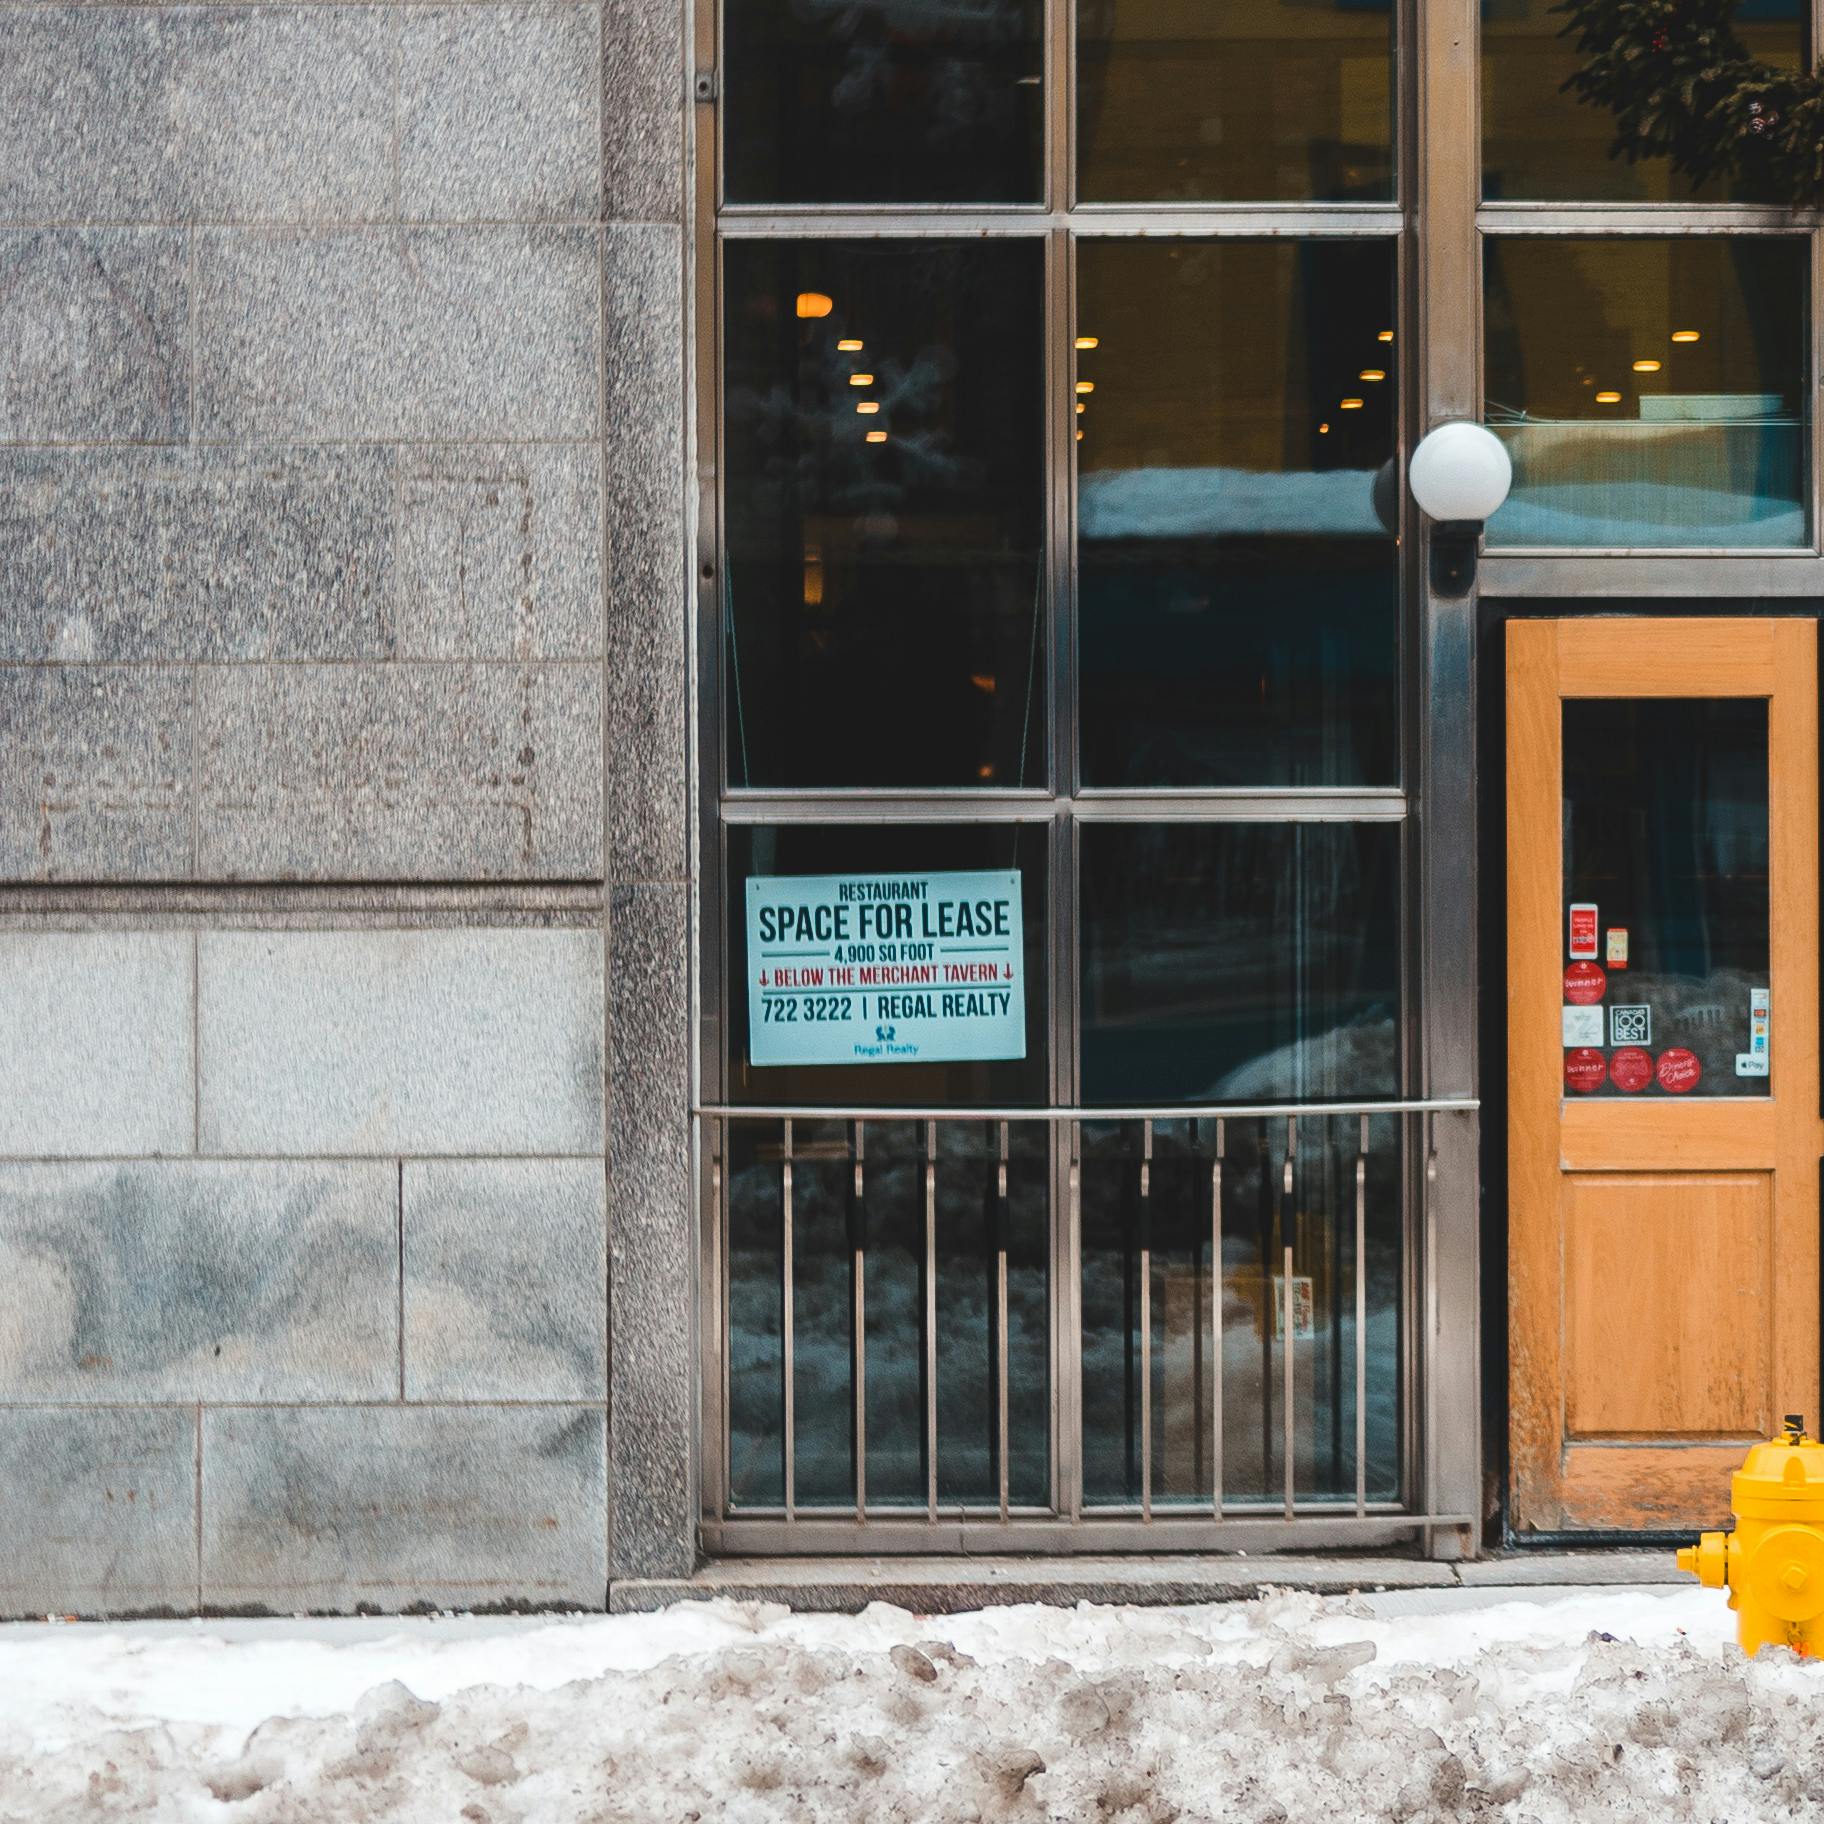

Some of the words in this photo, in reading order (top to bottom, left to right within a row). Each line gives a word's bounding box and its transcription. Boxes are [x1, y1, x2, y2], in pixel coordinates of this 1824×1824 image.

[839, 881, 928, 902] RESTAURANT
[759, 904, 850, 942] SPACE
[859, 903, 912, 940] FOR
[922, 900, 1010, 937] LEASE
[834, 944, 875, 964] 4,900
[879, 944, 897, 962] SQ
[900, 943, 934, 961] FOOT
[774, 967, 824, 987] BELOW
[828, 967, 855, 986] THE
[859, 965, 938, 985] MERCHANT
[943, 963, 998, 983] TAVERN
[761, 998, 798, 1022] 722
[803, 997, 852, 1021] 3222
[878, 995, 937, 1019] REGAL
[942, 992, 1010, 1018] REALTY
[1615, 1027, 1646, 1041] BEST
[854, 1044, 883, 1056] Regal
[886, 1043, 919, 1056] Realty
